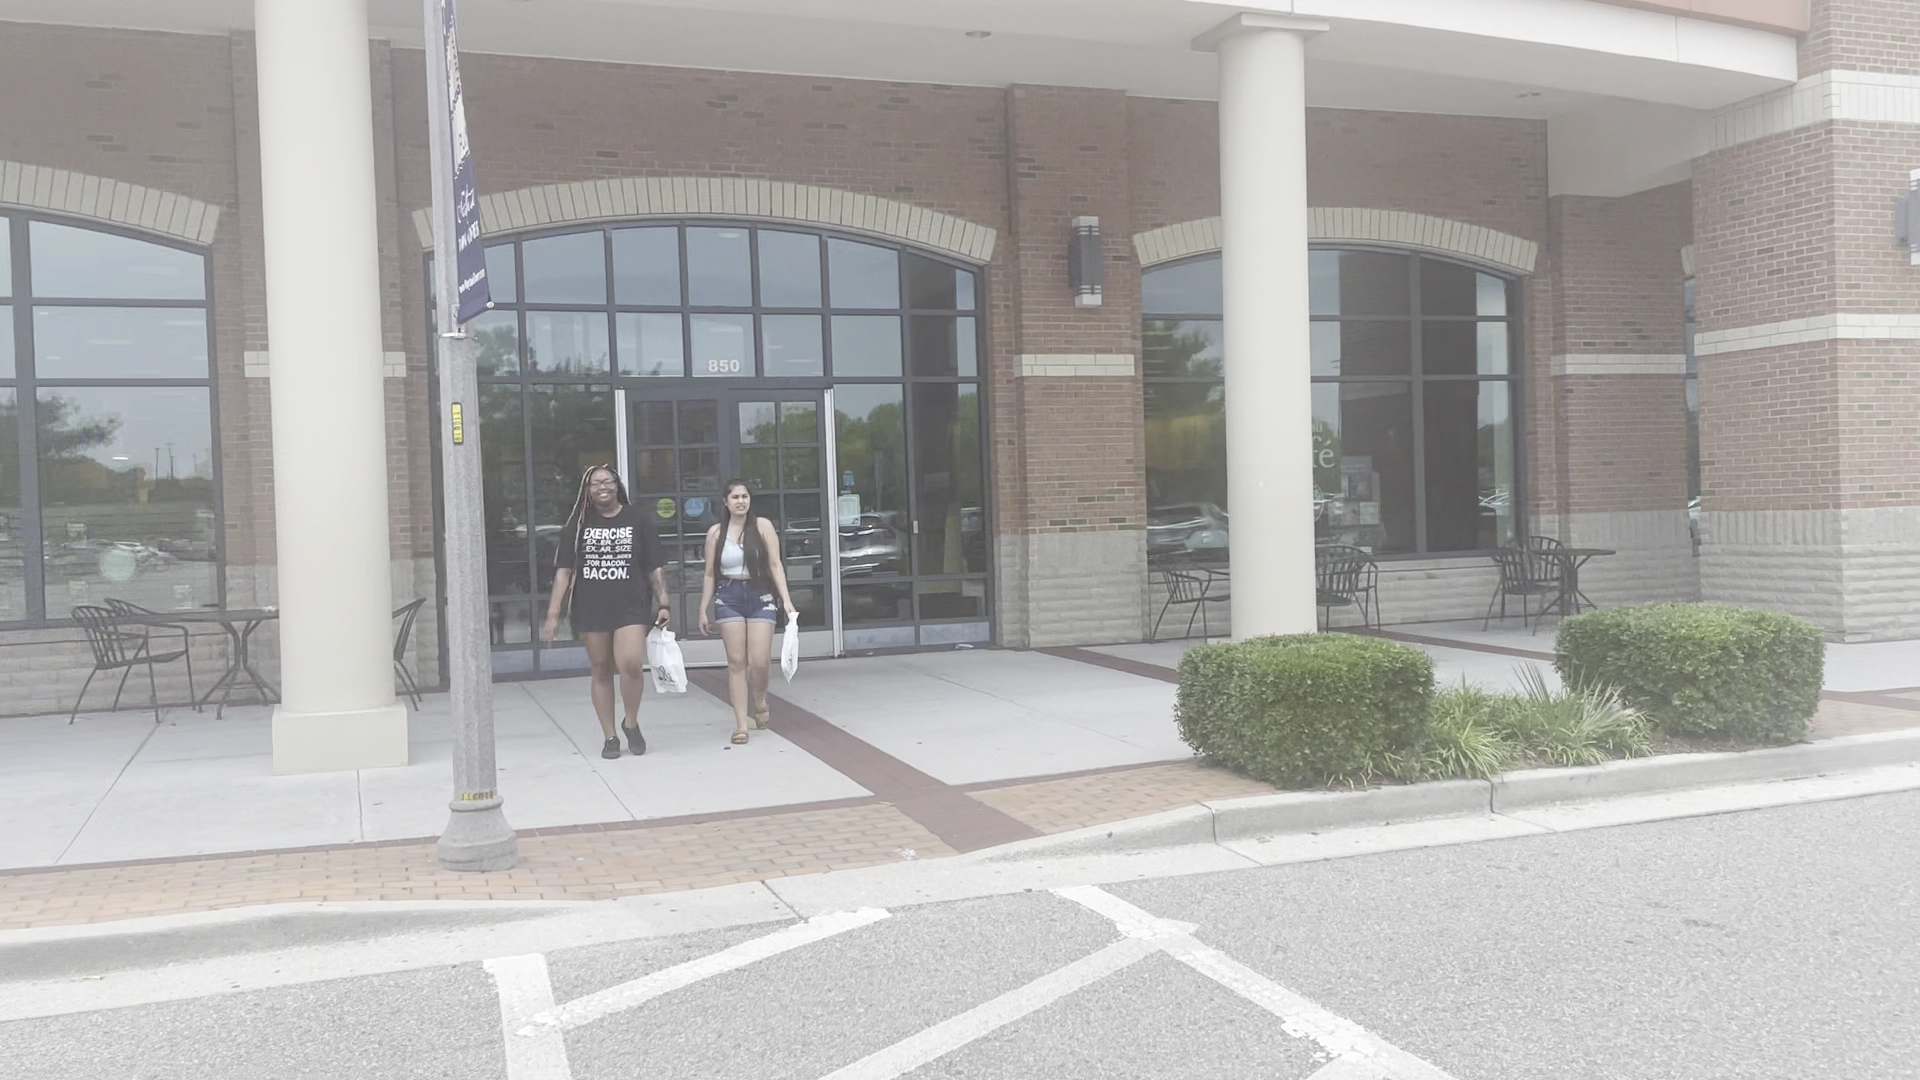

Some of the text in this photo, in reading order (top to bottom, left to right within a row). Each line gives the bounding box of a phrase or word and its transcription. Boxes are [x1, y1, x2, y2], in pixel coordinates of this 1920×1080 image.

[708, 359, 740, 372] 850
[583, 526, 633, 539] EXERCISE
[583, 567, 630, 580] BACON.
